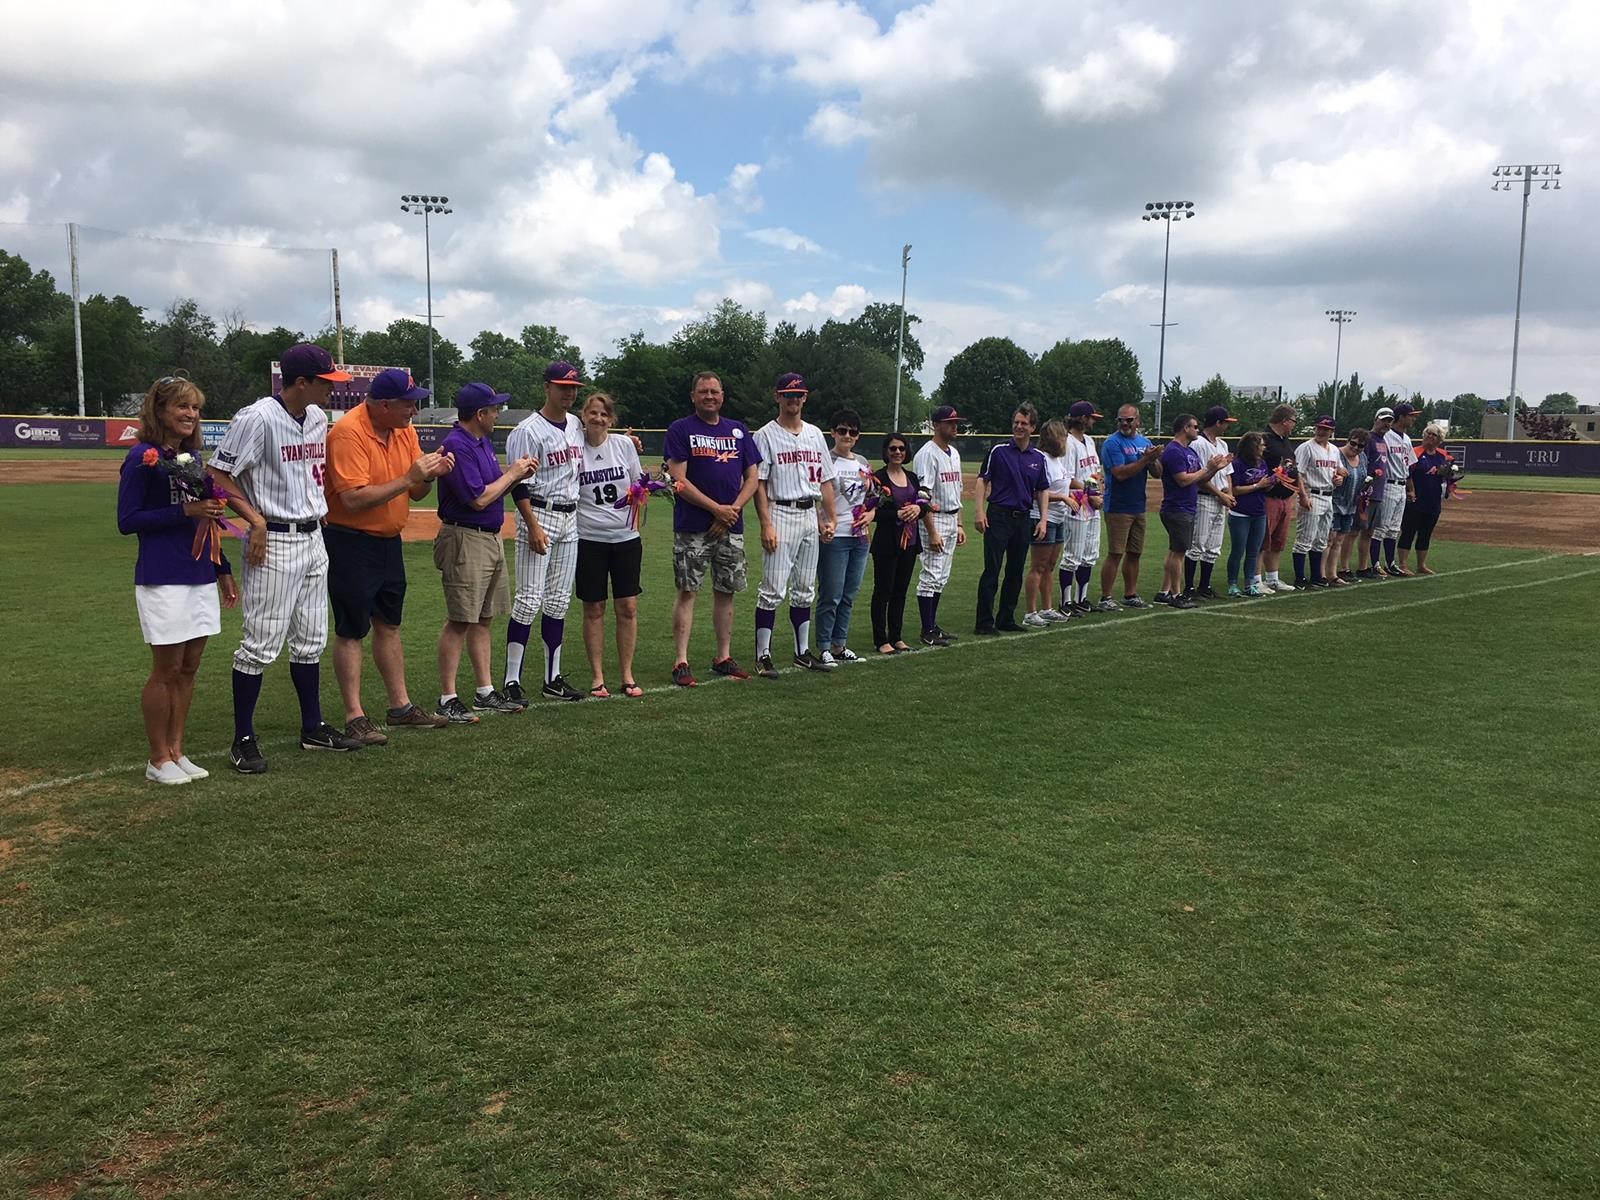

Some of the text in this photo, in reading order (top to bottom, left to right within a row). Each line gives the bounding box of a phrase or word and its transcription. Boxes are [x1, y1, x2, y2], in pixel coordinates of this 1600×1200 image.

[14, 422, 60, 439] GIBCO
[689, 434, 738, 451] EVANSVILLE
[281, 443, 325, 462] EVANSVILLE
[777, 450, 822, 465] EVANSVILLE
[580, 466, 625, 486] EVANSVILLE
[593, 484, 618, 505] 19
